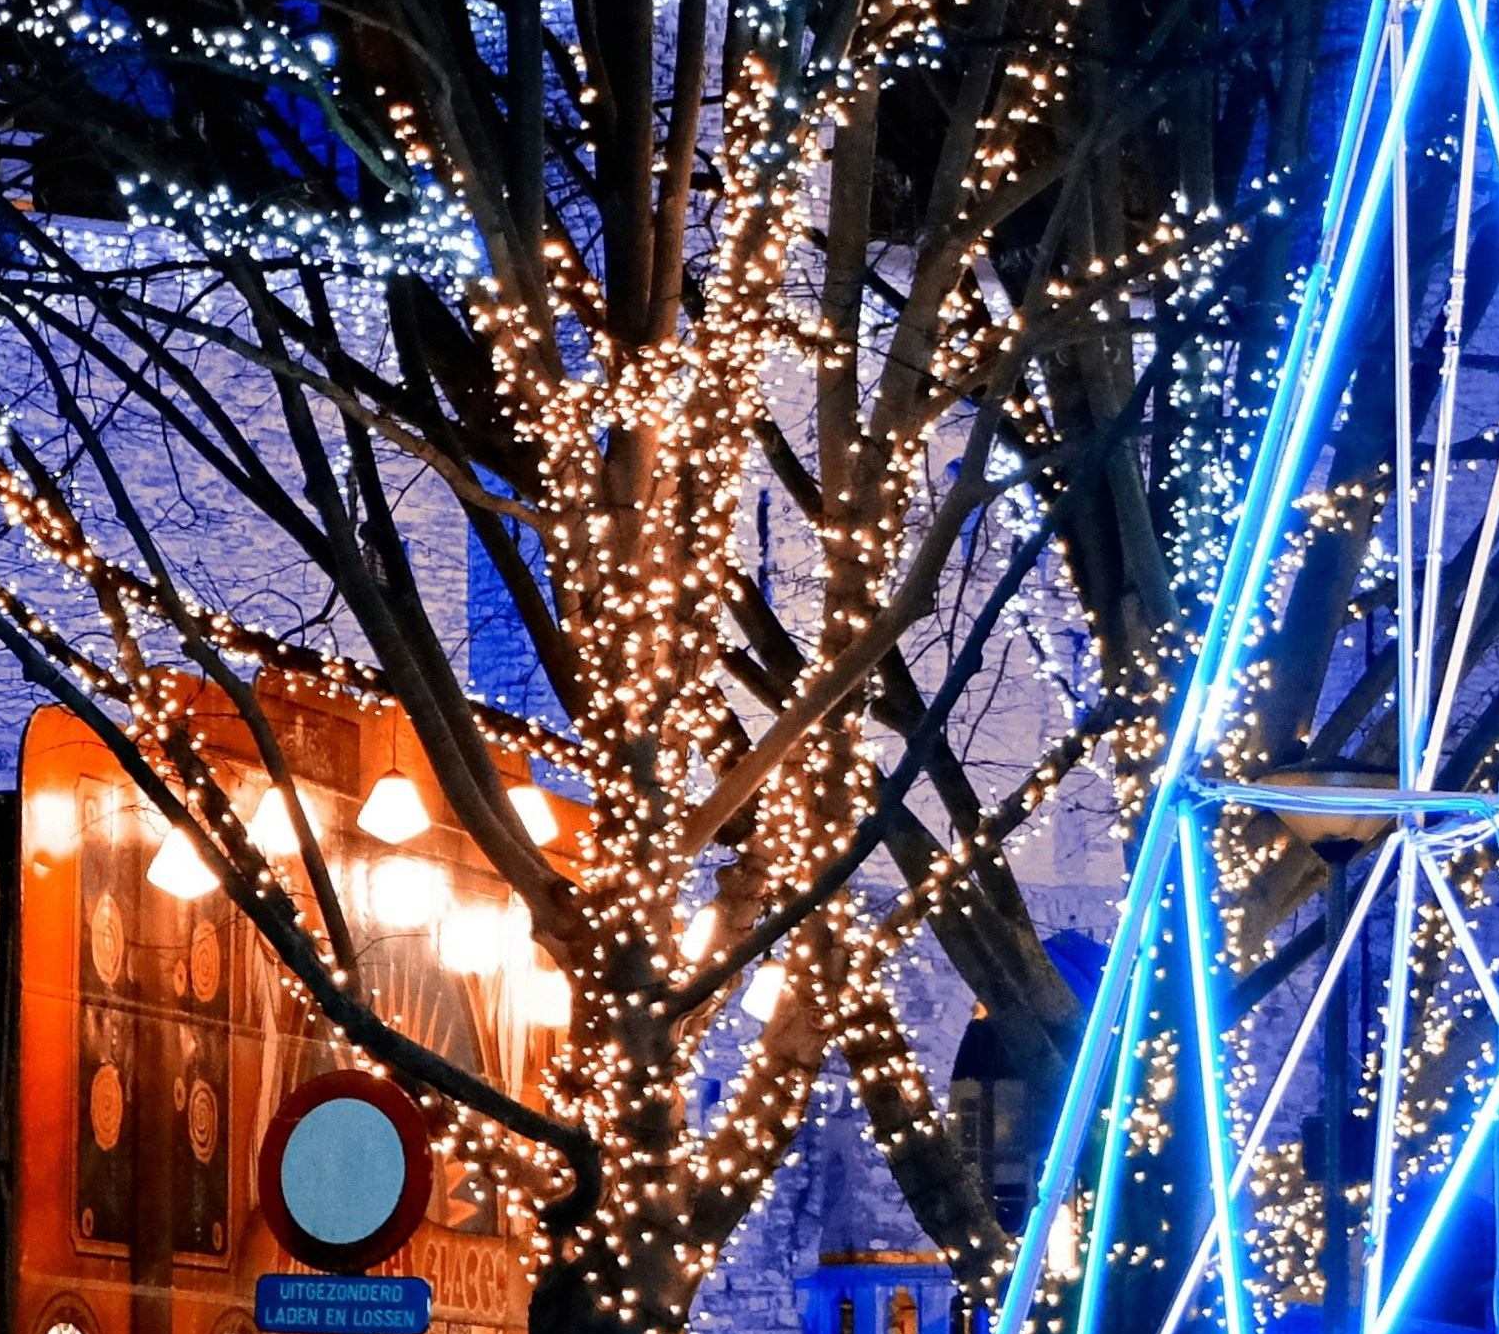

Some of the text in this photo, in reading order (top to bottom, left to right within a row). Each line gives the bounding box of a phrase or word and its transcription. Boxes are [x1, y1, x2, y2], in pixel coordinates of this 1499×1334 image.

[279, 1282, 404, 1303] UITGEZONDERD
[264, 1307, 416, 1328] LADEN EN LOSSEN
